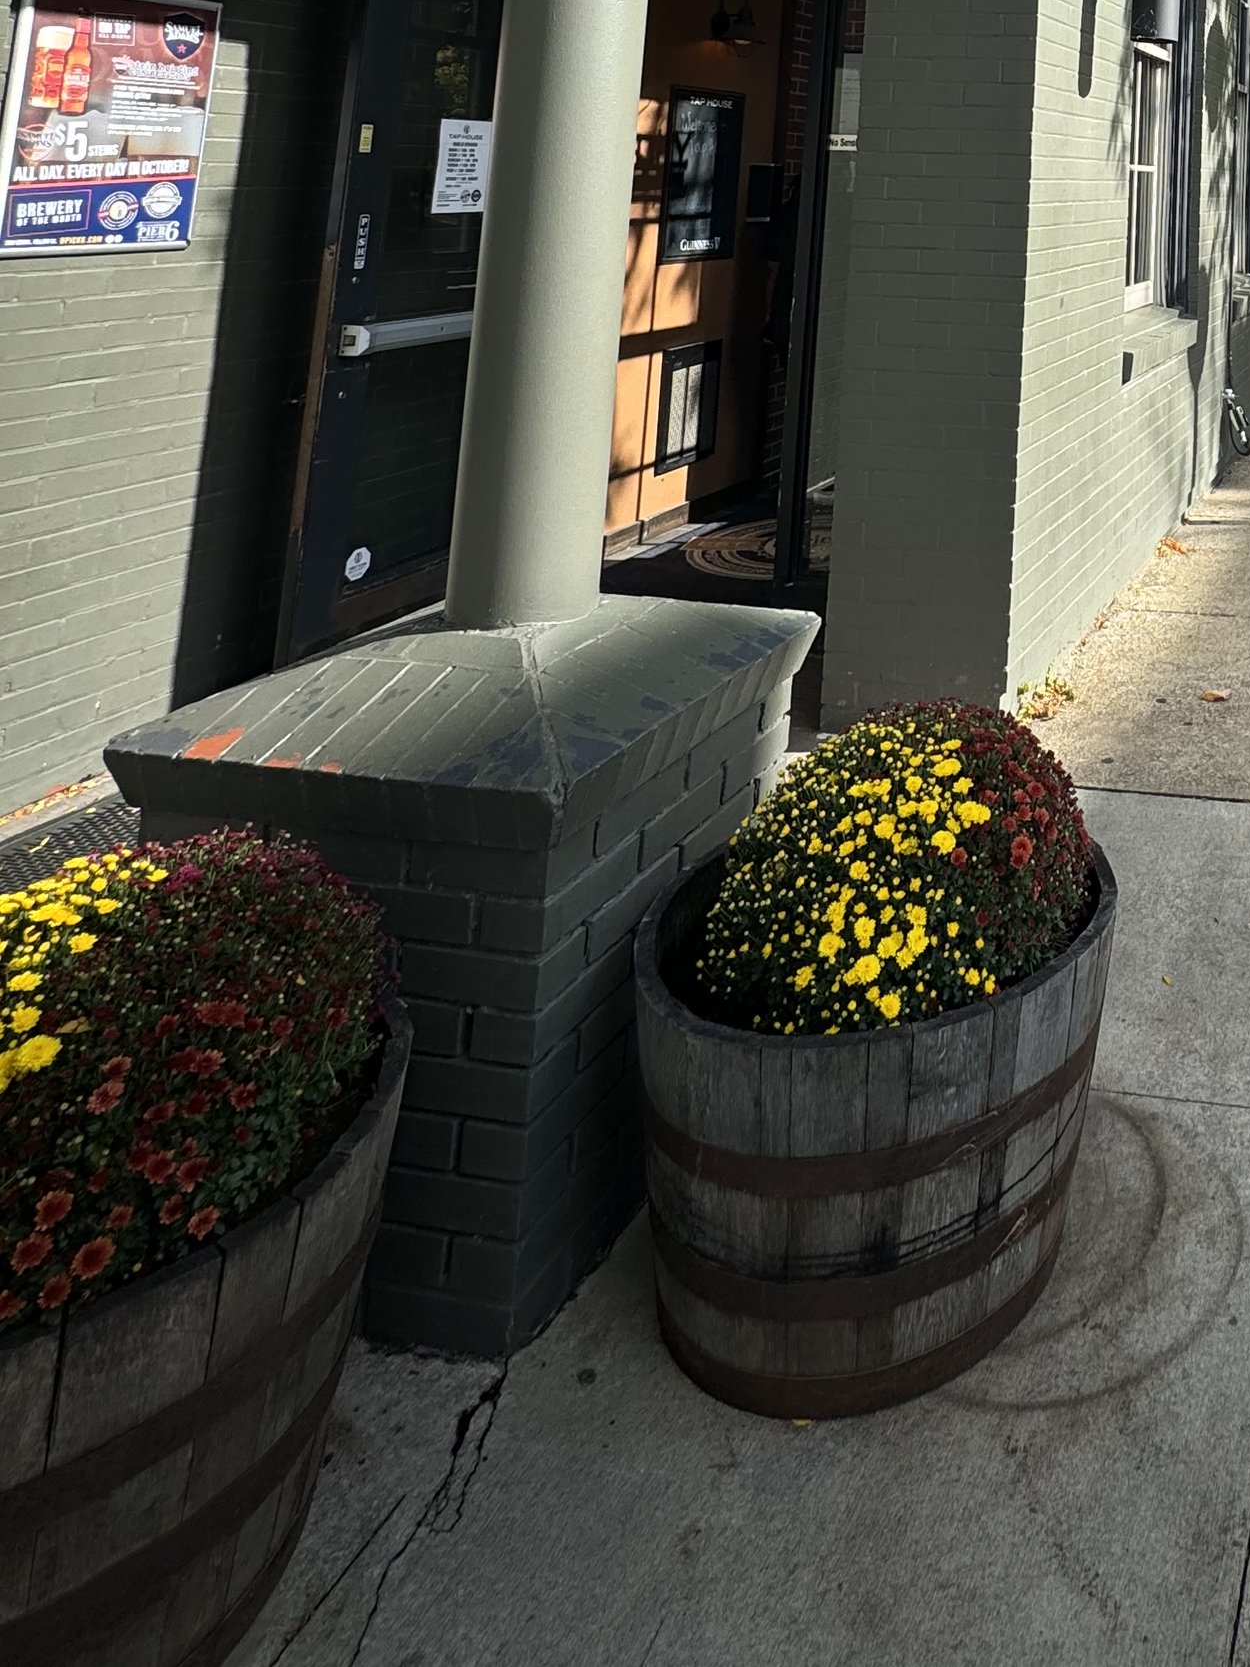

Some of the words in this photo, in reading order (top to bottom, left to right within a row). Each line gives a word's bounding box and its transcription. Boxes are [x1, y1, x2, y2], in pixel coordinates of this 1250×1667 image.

[164, 21, 203, 36] SAMUEL
[166, 33, 200, 44] ADAMS
[690, 96, 706, 105] TAP
[706, 98, 733, 109] HOUSE
[13, 166, 37, 182] ALL
[67, 162, 103, 179] EVERY
[105, 161, 128, 177] DAY
[129, 161, 141, 175] IN
[142, 159, 189, 174] OCTOBER!
[16, 199, 83, 218] BREWERY
[16, 217, 28, 227] OF
[32, 216, 50, 225] THE
[51, 214, 82, 224] MONTH
[139, 226, 165, 237] PIER
[165, 220, 180, 241] 6
[357, 217, 368, 255] PUSH
[680, 238, 715, 251] GUINNESS
